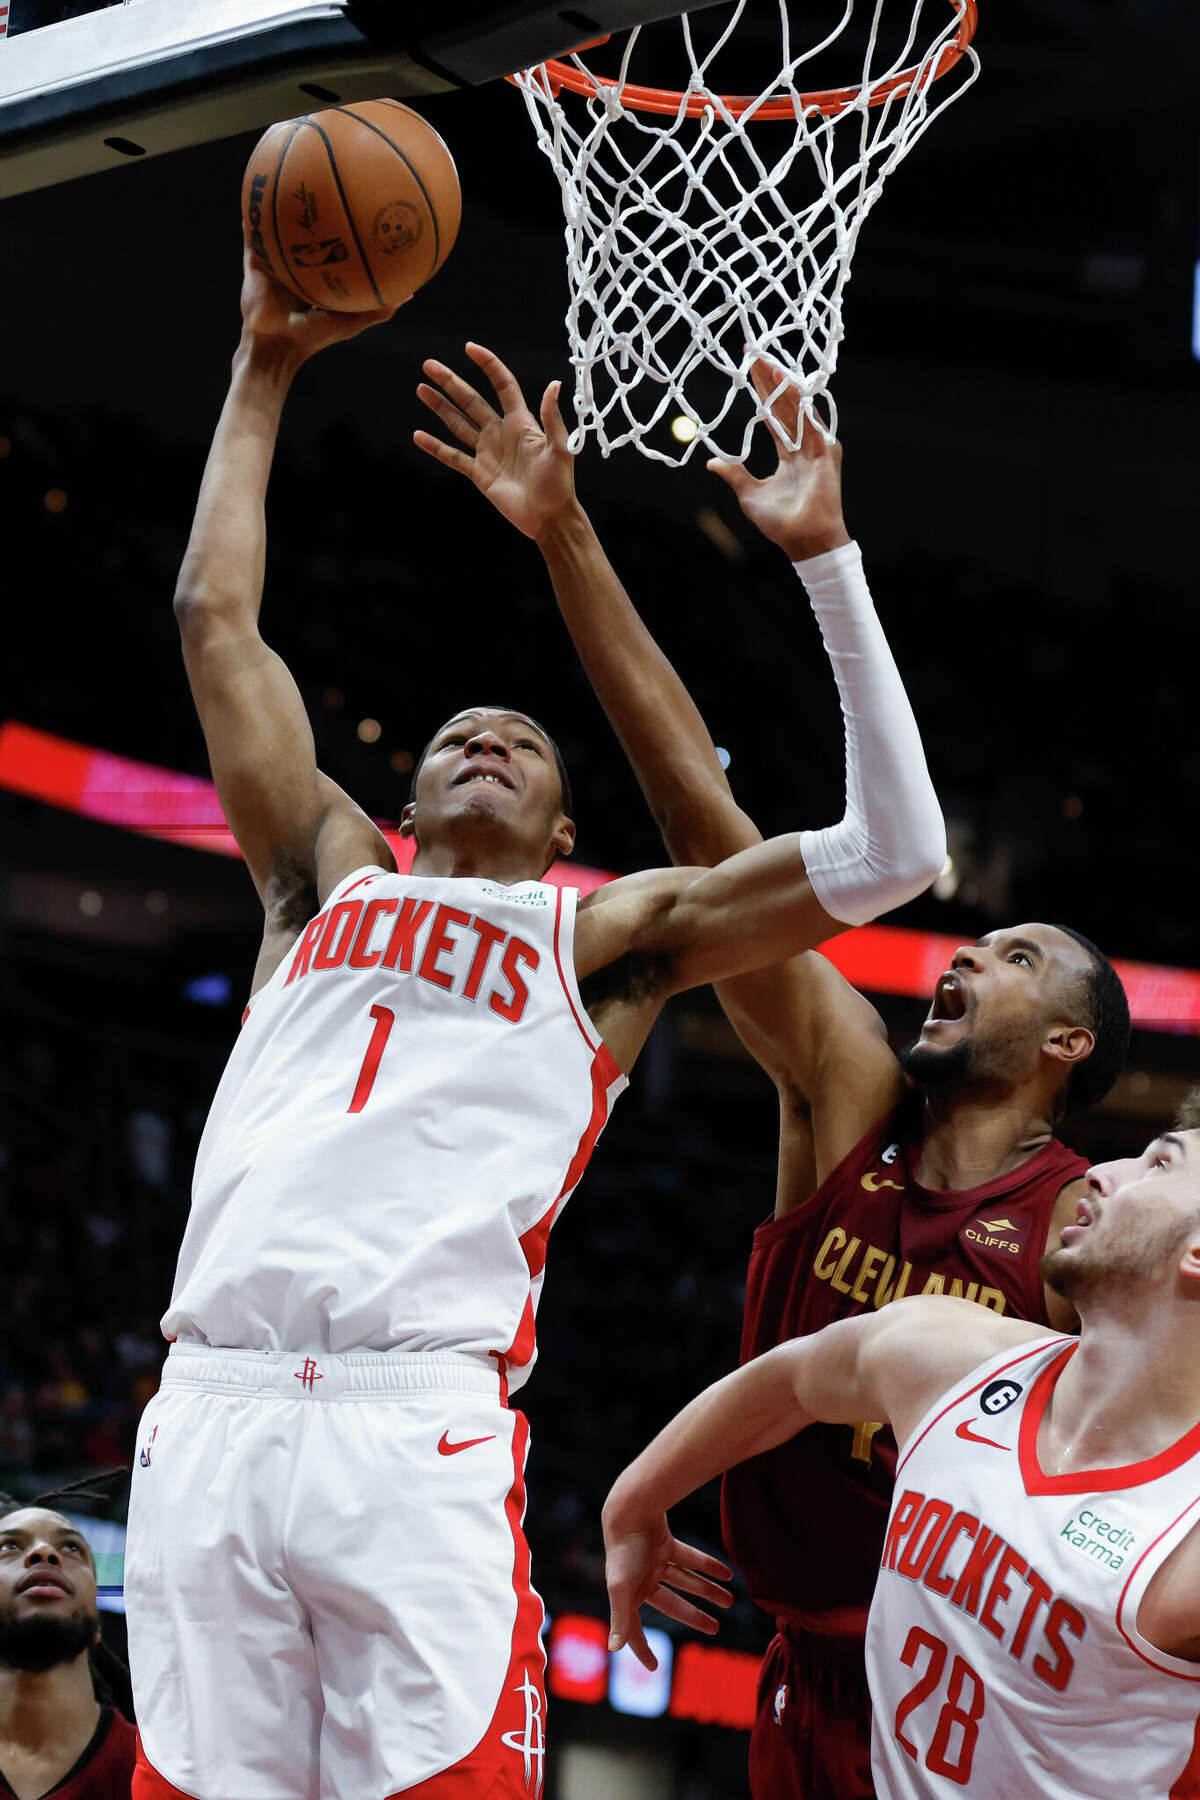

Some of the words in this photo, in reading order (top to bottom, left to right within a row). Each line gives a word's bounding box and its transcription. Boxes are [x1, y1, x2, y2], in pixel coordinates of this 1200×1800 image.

[281, 897, 540, 1025] ROCKETS
[346, 1003, 396, 1114] 1
[814, 1226, 1006, 1315] CLEVLAD
[965, 1229, 1020, 1254] CLIFFS
[986, 1385, 1019, 1413] 6
[1060, 1519, 1124, 1570] karma
[1079, 1510, 1135, 1551] credit
[882, 1490, 1086, 1692] ROCKETS
[895, 1626, 985, 1785] 28
